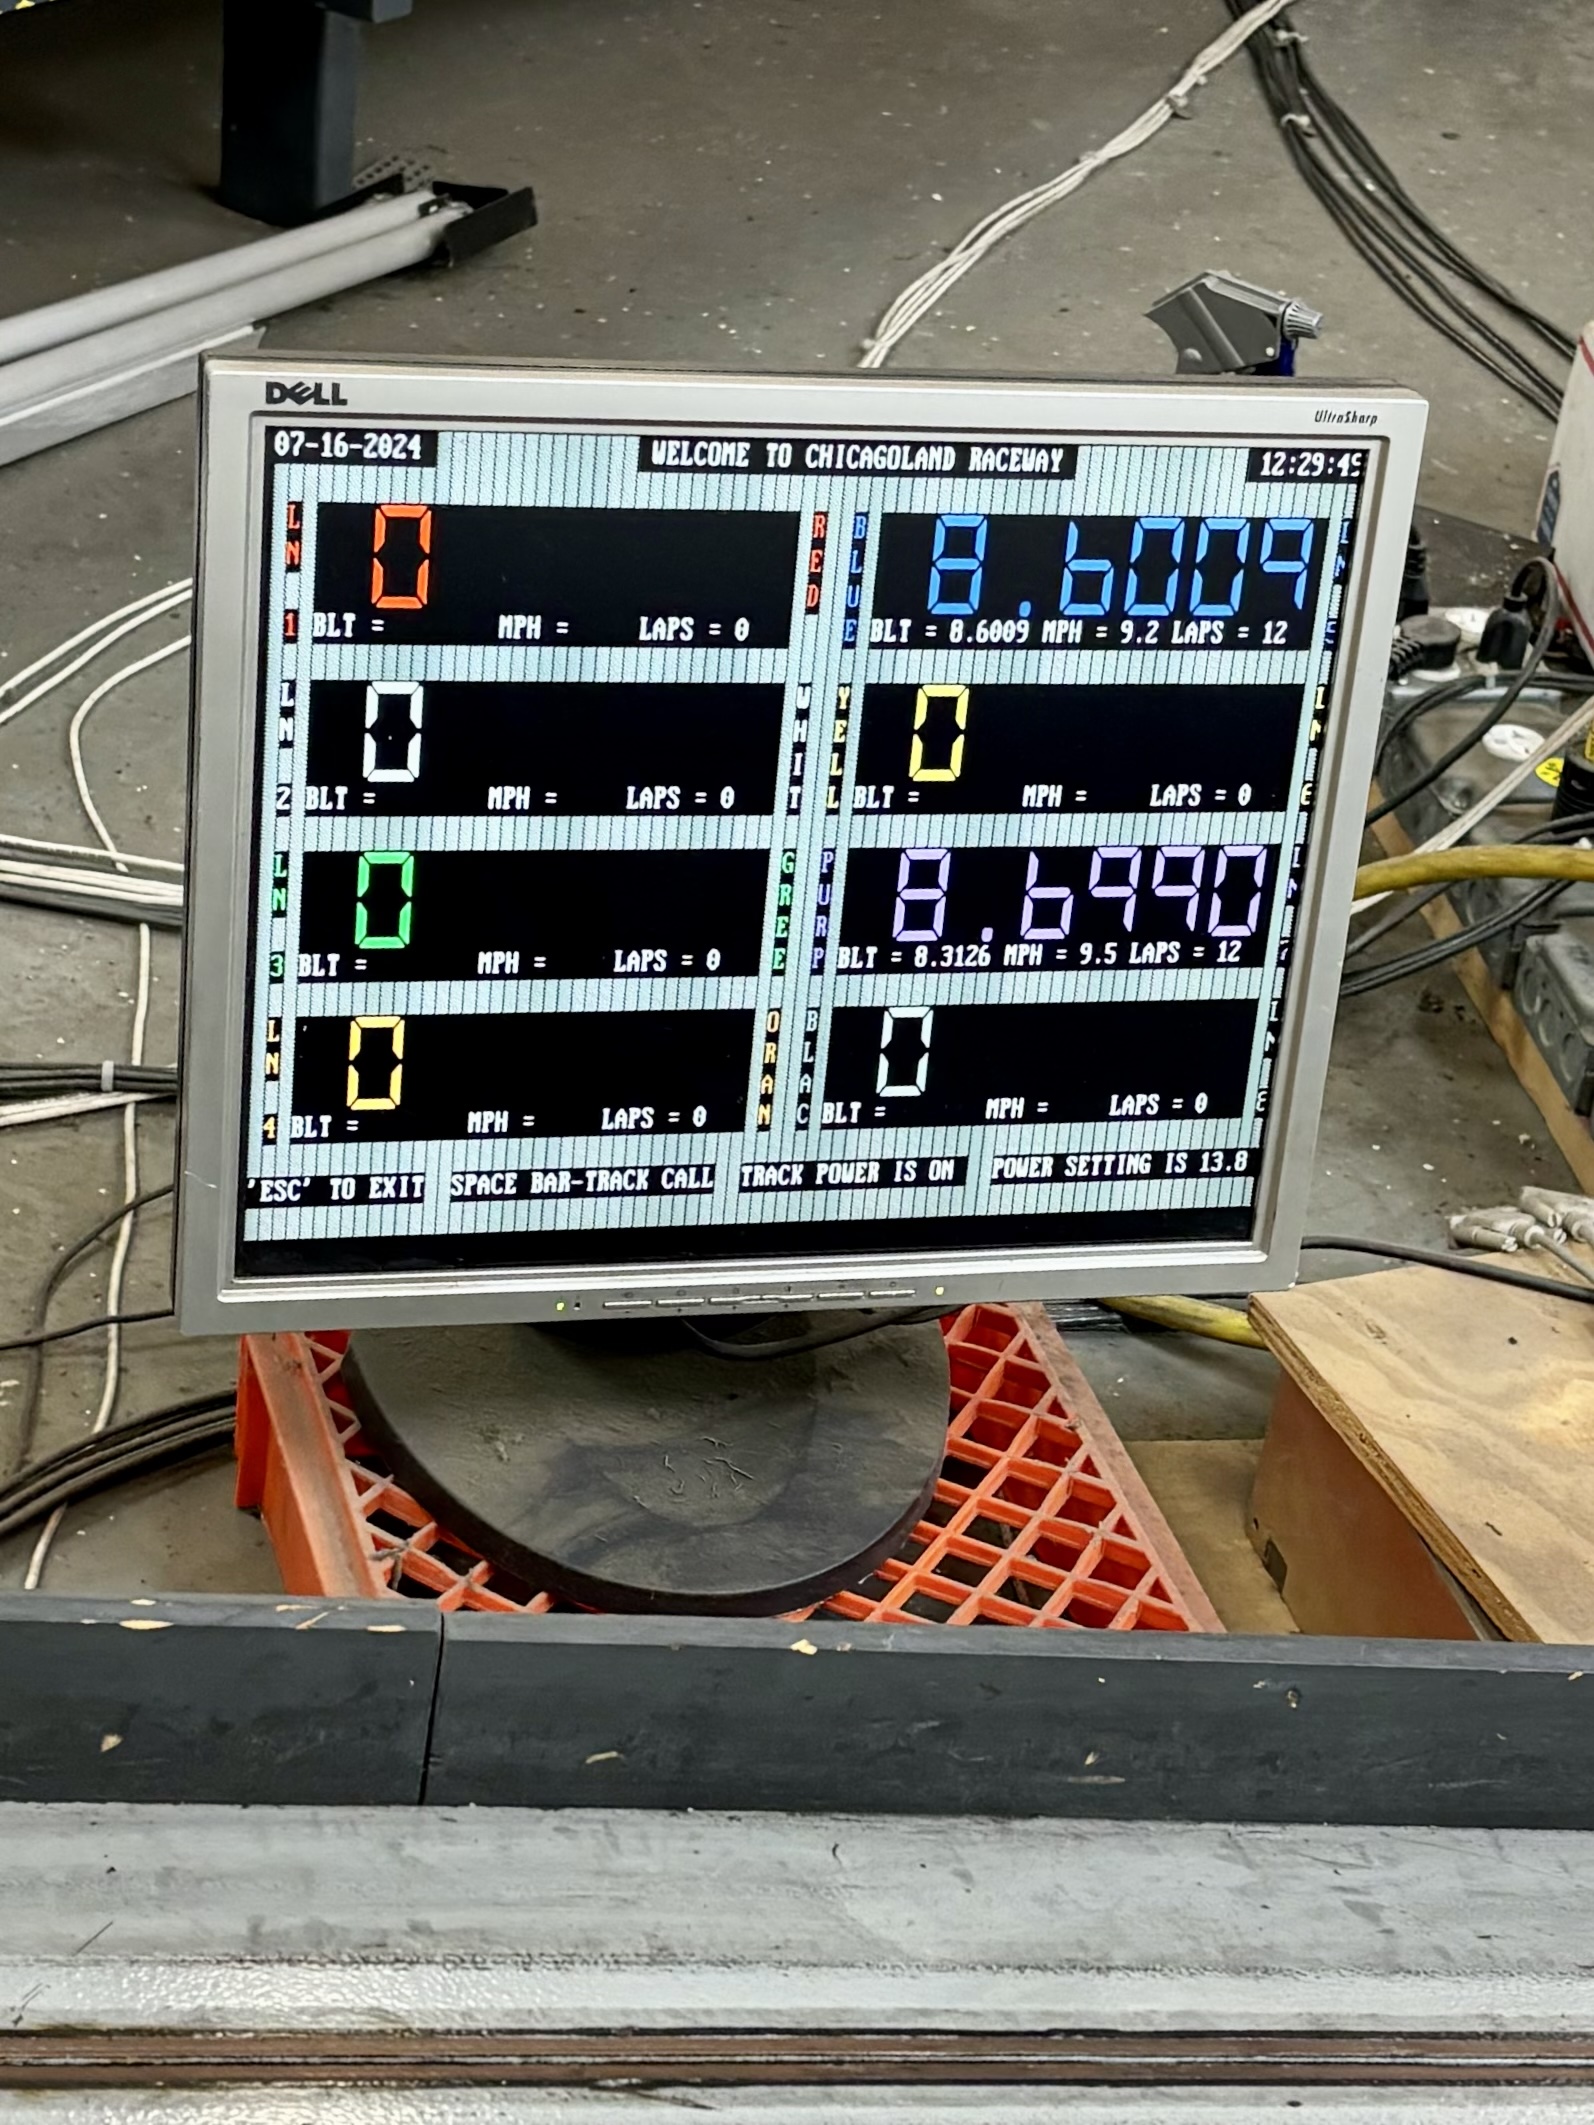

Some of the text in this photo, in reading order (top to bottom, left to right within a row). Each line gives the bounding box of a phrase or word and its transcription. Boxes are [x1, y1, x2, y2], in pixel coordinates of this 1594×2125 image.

[265, 382, 348, 406] DELL
[1314, 409, 1378, 427] UltraSharp
[274, 431, 422, 460] 07-16-2024
[651, 440, 1064, 474] WELCOME TO CHICAGOLAND RACEWAY
[371, 503, 433, 609] 0
[928, 514, 1315, 619] 8.6009
[284, 612, 297, 637] 1
[313, 611, 750, 642] BLT = MPH = LAPS = 0
[869, 618, 1289, 646] BLT = 8.6009 MPH = 9.2 LAPS = 12
[363, 680, 424, 783] 0
[909, 684, 970, 782] 0
[276, 786, 291, 810] 2
[304, 785, 735, 810] BLT = MPH = LAPS = 0
[852, 782, 1252, 809] BLT = MPH = LAPS = 0
[355, 851, 414, 949] 0
[892, 845, 1267, 942] 8.6990
[270, 955, 284, 977] 3
[296, 947, 721, 977] BLT = MPH = LAPS = 0
[836, 940, 1242, 969] BLT = 8.3126 MPH = 9.5 LAPS = 12
[347, 1016, 405, 1110] 0
[876, 1006, 934, 1097] 0
[290, 1105, 707, 1139] BLT = MPH = LAPS = 0
[822, 1091, 1209, 1124] BLT = MPH = LAPS = 0
[263, 1116, 276, 1139] 4
[740, 1158, 955, 1187] TRACK POWER IS ON
[990, 1150, 1249, 1180] POWER SETTING IS 13.8
[330, 1176, 355, 1200] TO
[369, 1175, 425, 1199] EXIT
[449, 1167, 715, 1197] SPACE BAR-TRACK CALL
